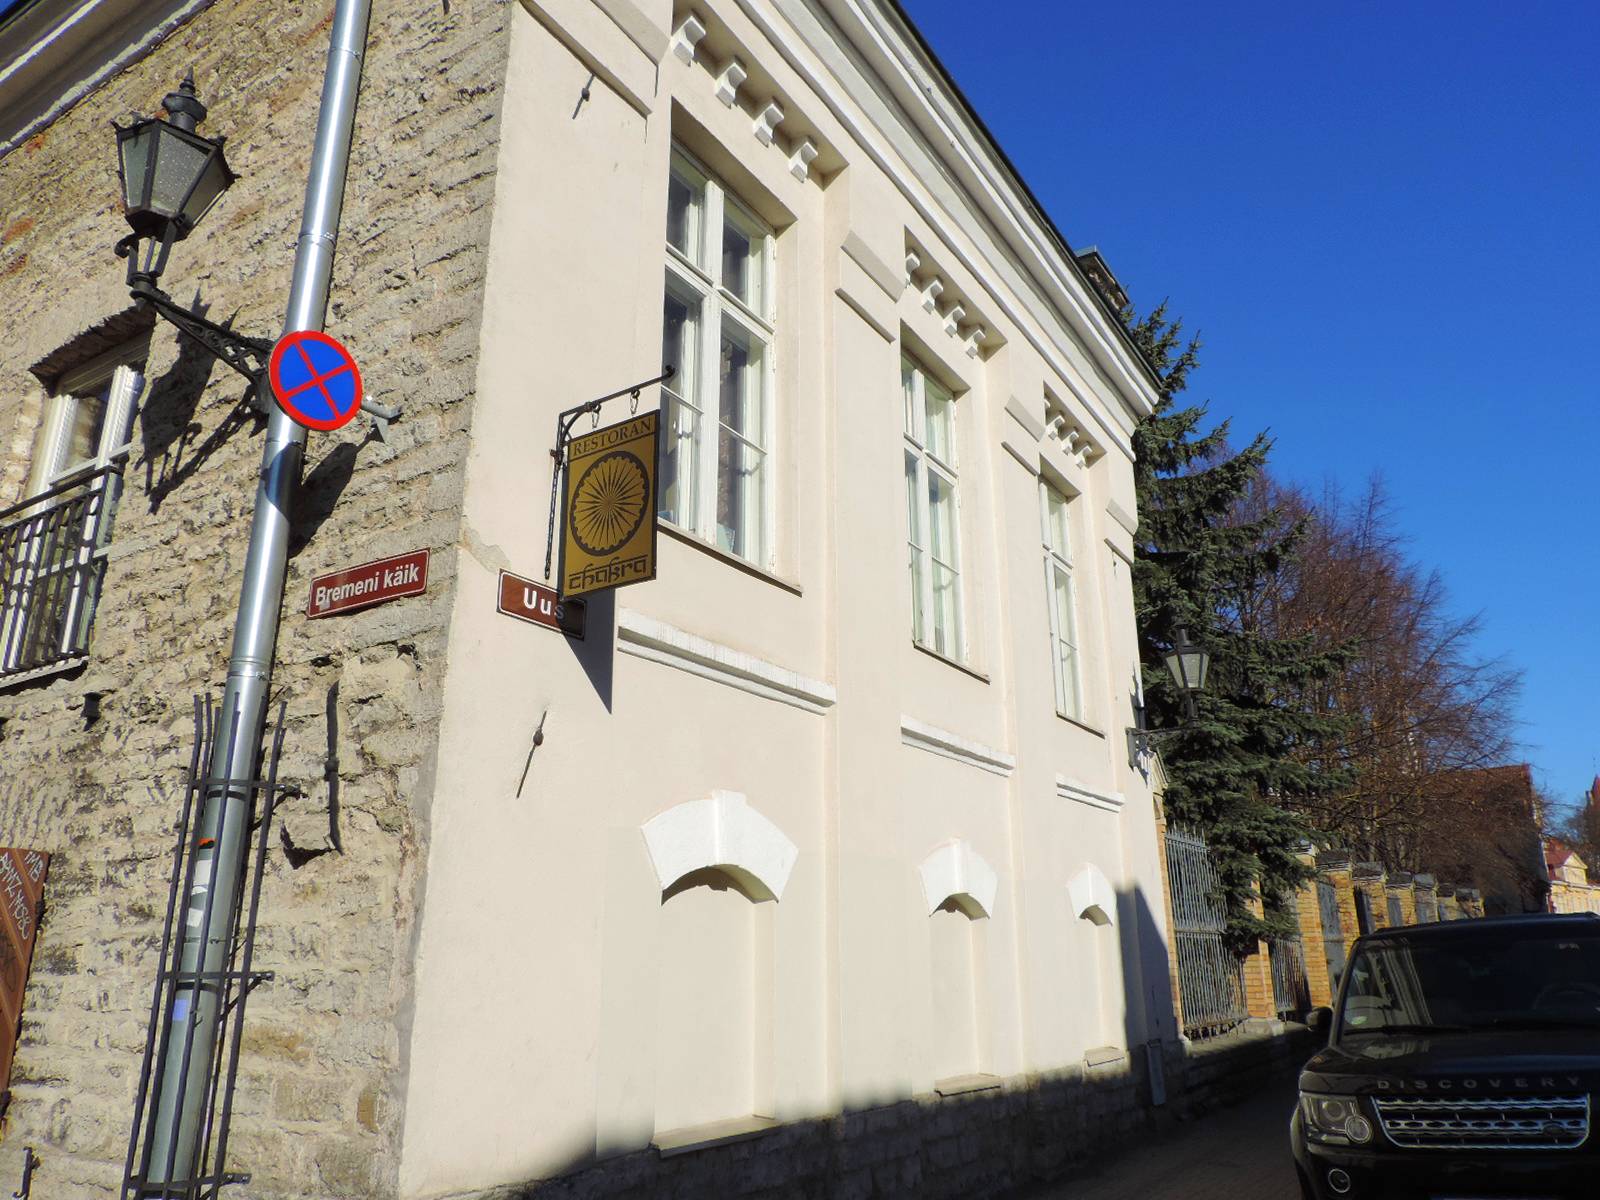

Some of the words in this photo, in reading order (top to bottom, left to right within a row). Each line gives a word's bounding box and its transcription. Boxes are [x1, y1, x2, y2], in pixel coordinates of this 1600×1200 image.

[573, 416, 652, 457] RESTORAN
[315, 571, 380, 606] Bremeni
[383, 563, 420, 589] käik
[569, 554, 648, 590] chakra
[523, 586, 565, 620] Uus
[1377, 1076, 1581, 1090] DISCOVERY
